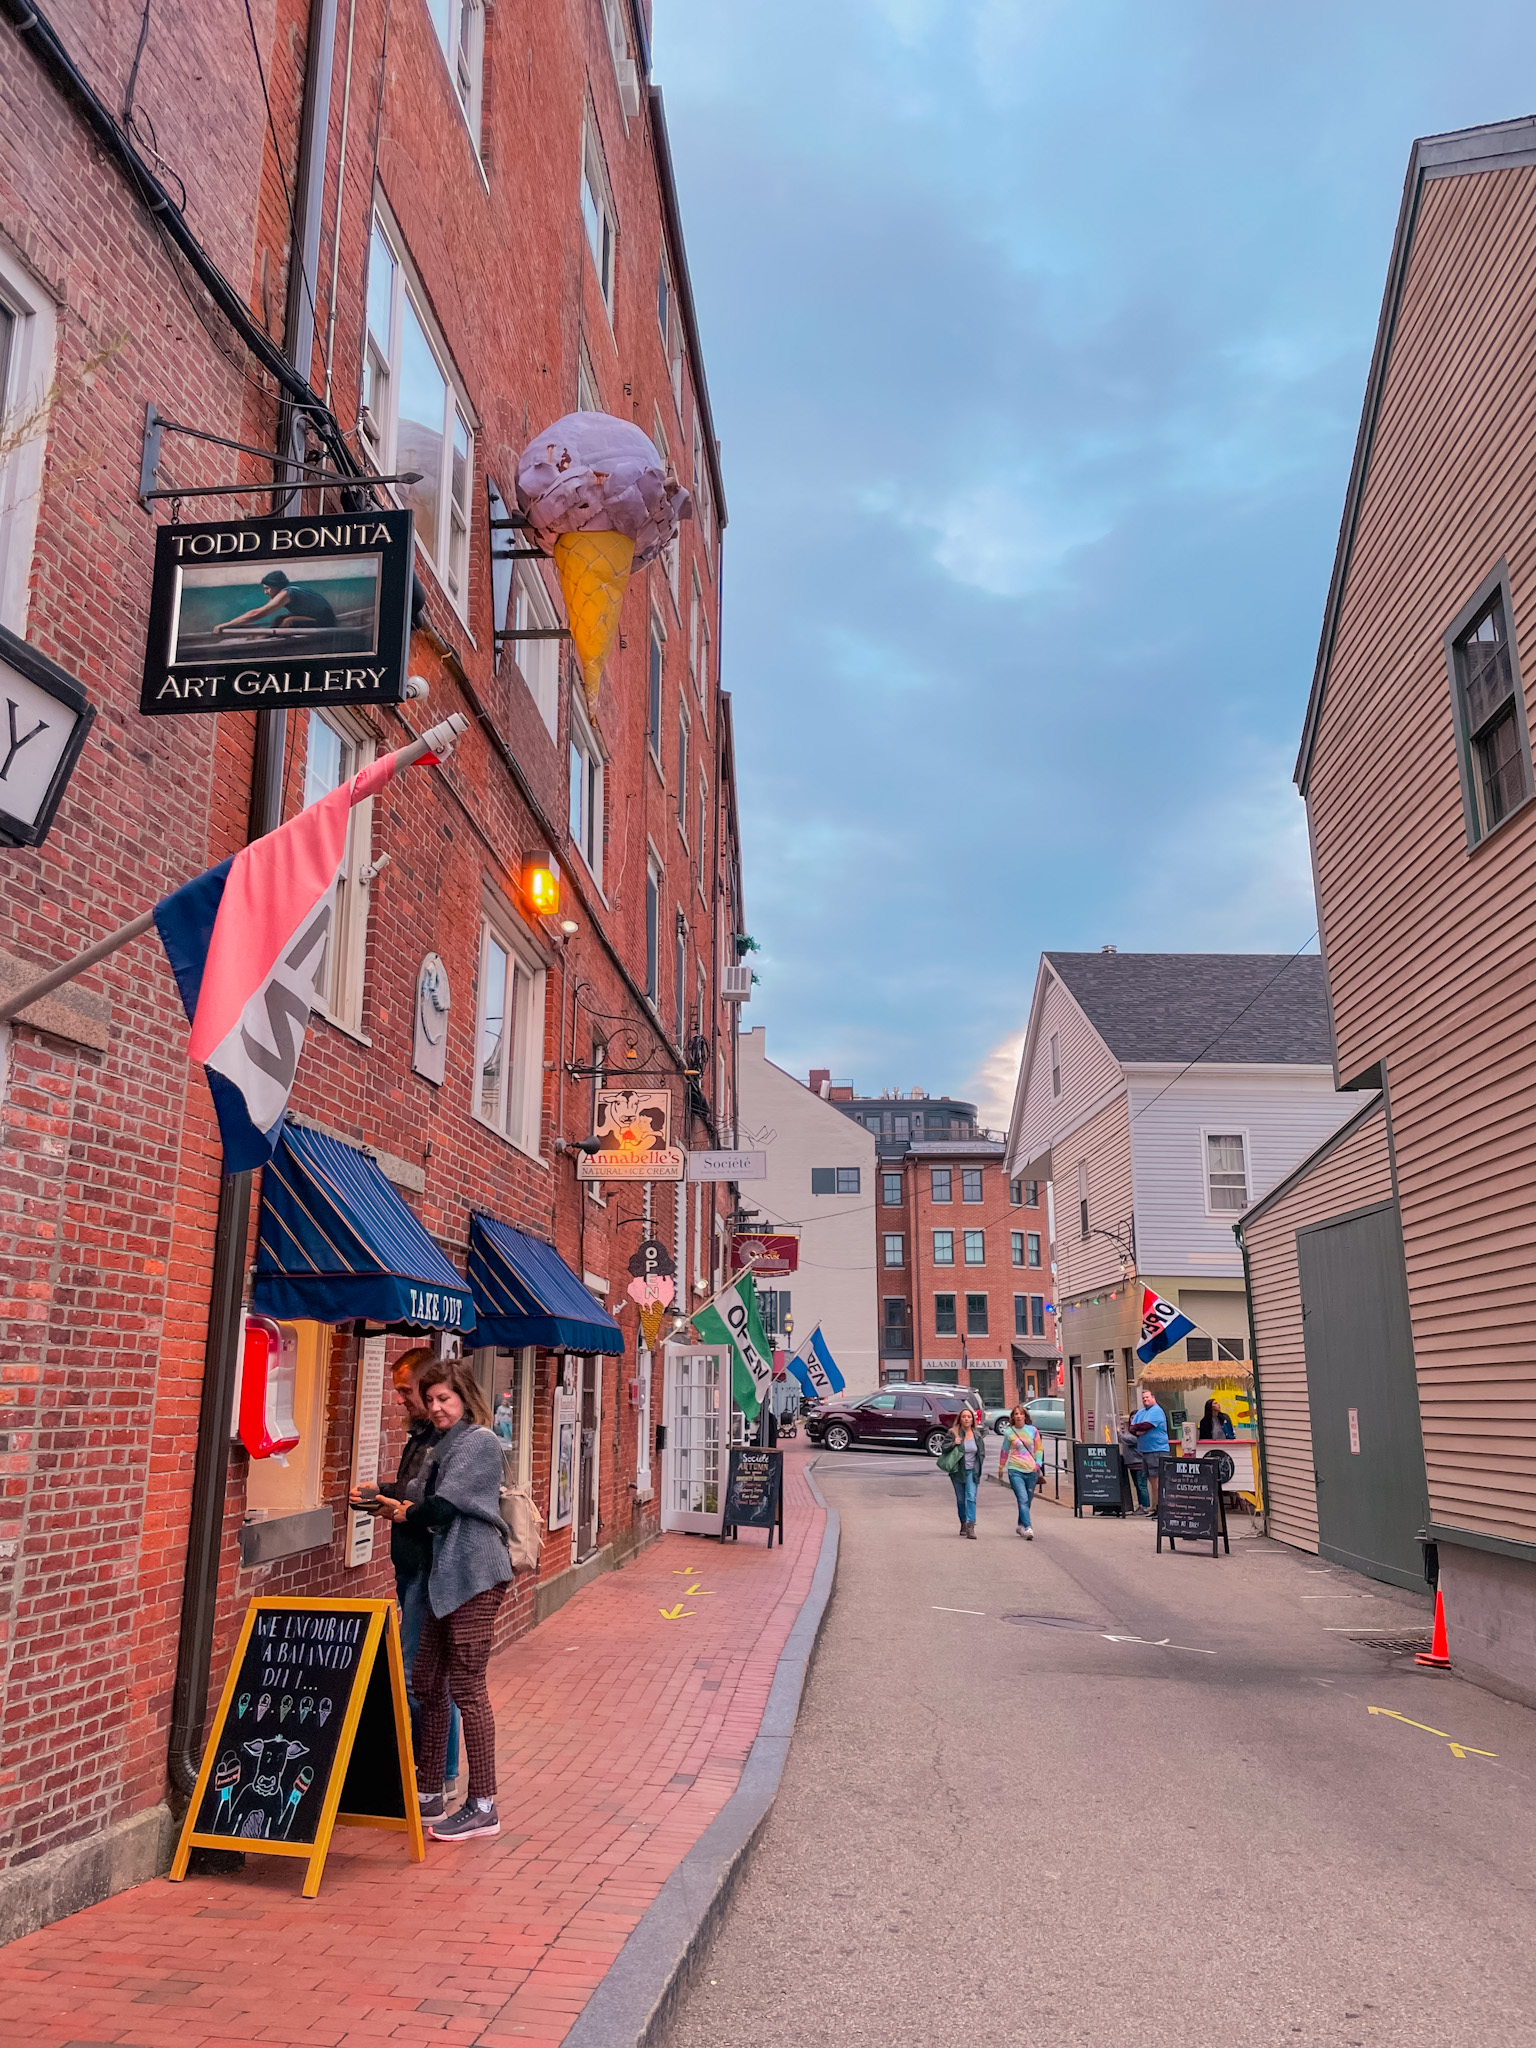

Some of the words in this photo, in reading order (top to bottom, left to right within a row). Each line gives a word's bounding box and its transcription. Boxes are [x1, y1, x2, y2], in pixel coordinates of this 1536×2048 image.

[172, 532, 260, 556] TODD
[272, 523, 393, 550] BONITA
[156, 675, 225, 699] ART
[233, 667, 388, 695] GALLERY
[582, 1151, 680, 1165] Annabelle's
[704, 1157, 751, 1169] Société
[582, 1167, 623, 1176] NATURAL
[629, 1167, 645, 1175] ICE
[647, 1167, 678, 1175] CREAM
[645, 1246, 658, 1299] OPEN
[411, 1288, 440, 1321] TAKE
[443, 1295, 463, 1326] OUT
[926, 1360, 957, 1368] ALAND
[969, 1360, 1004, 1368] REALTY
[1176, 1463, 1188, 1474] ICE
[1188, 1463, 1200, 1474] PIK
[258, 1615, 282, 1638] WE
[262, 1642, 272, 1662] A
